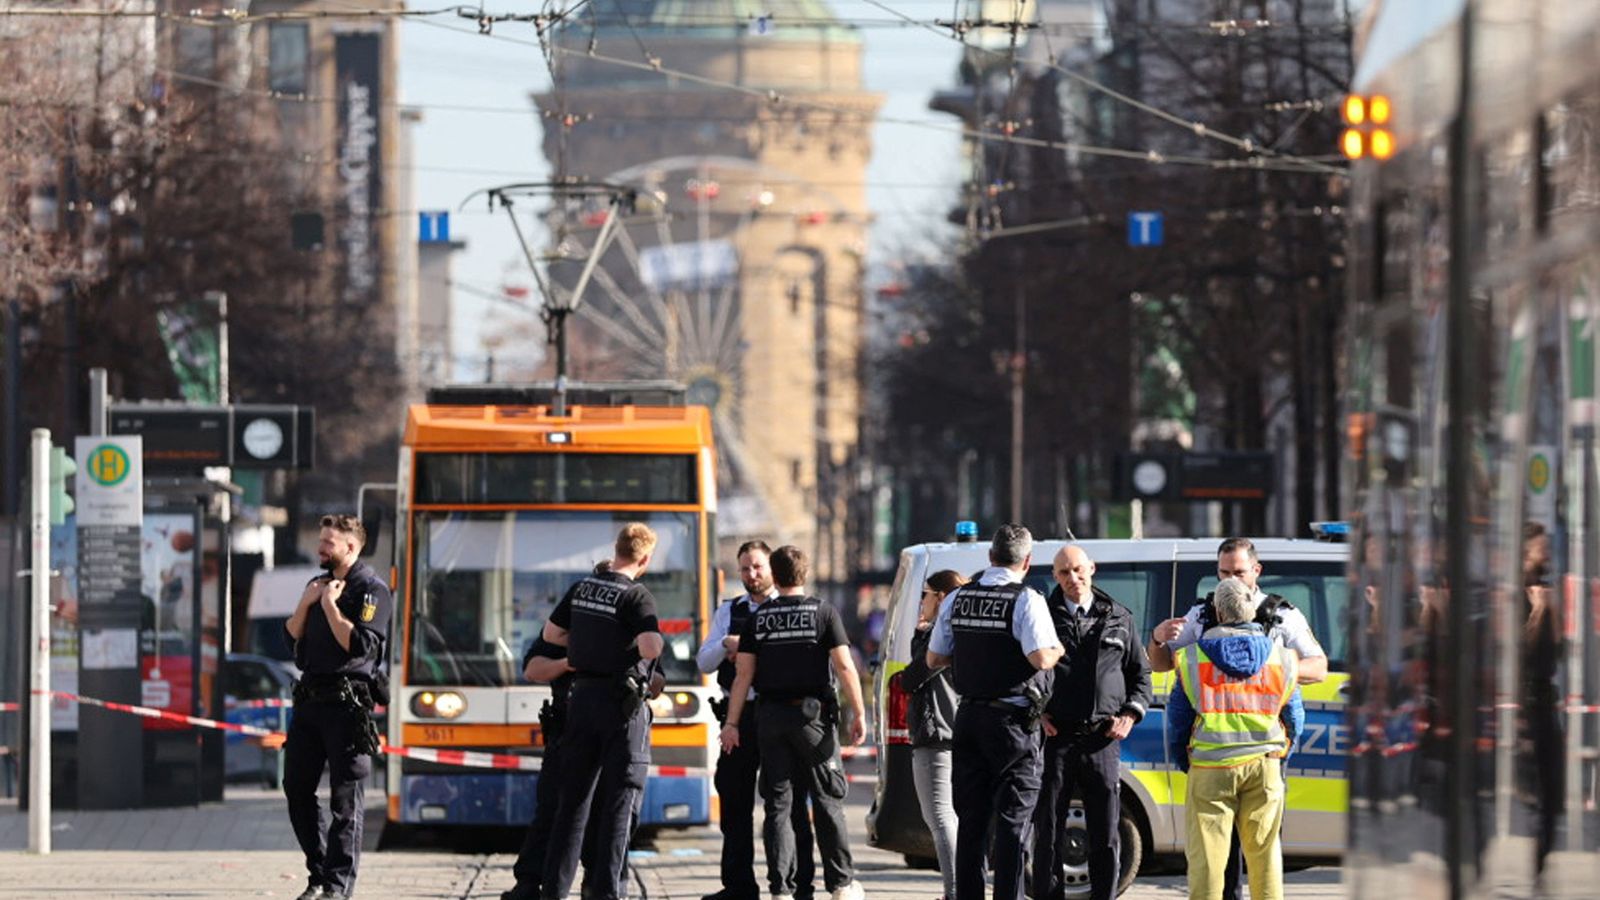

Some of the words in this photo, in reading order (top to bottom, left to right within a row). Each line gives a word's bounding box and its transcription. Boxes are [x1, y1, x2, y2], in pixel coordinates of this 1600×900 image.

[1134, 212, 1156, 245] T
[574, 582, 621, 606] POLIZEI
[953, 598, 1009, 618] POLIZEI
[756, 612, 817, 632] POLIZEI
[423, 727, 455, 741] 5611
